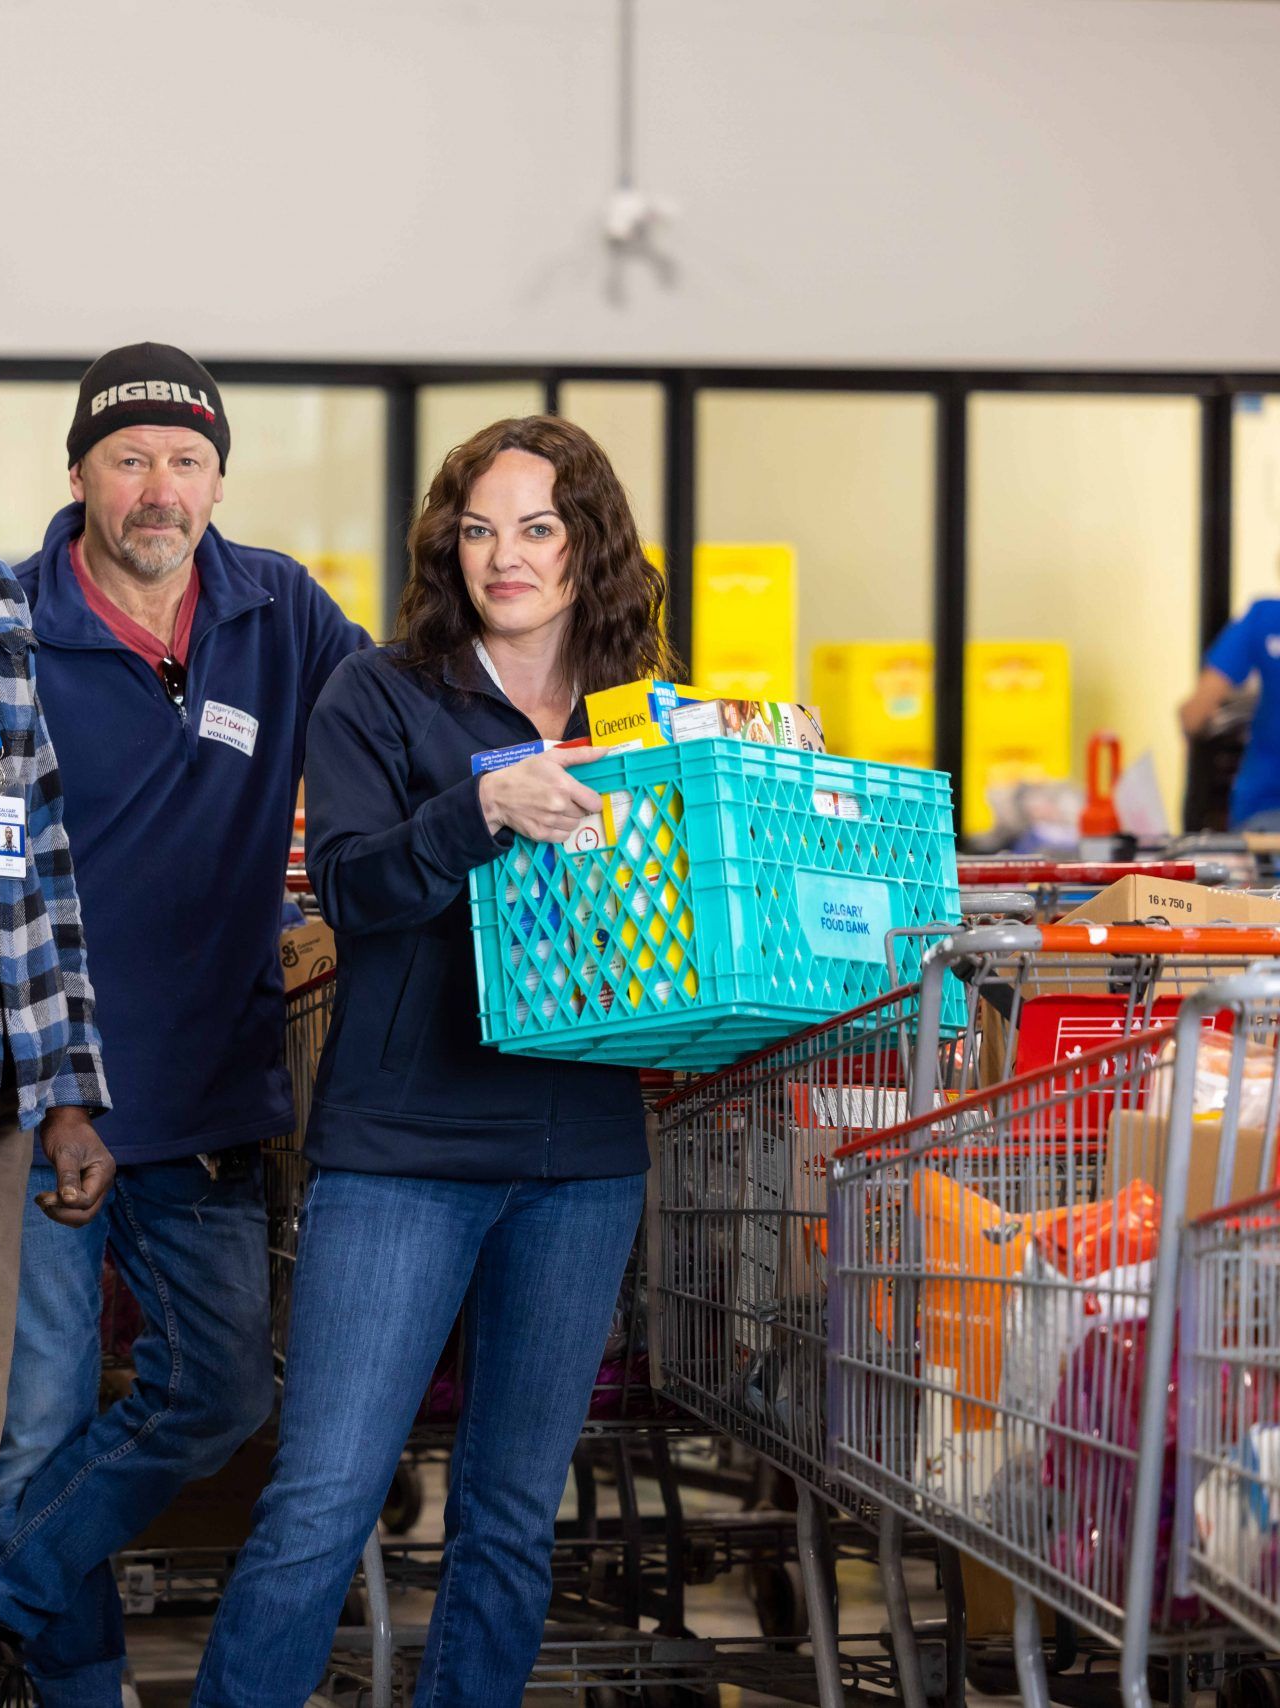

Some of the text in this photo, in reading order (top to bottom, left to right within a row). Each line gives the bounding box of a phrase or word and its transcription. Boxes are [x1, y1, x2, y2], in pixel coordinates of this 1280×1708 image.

[91, 380, 215, 416] BIGBILL
[595, 712, 646, 738] Cheerios
[784, 716, 792, 745] HIGH
[207, 730, 248, 750] VOLUNTEER
[823, 902, 863, 918] CALGARY
[1148, 894, 1159, 905] 16
[1168, 897, 1184, 909] 750
[1186, 903, 1192, 912] g
[821, 917, 870, 935] FOOD BANK
